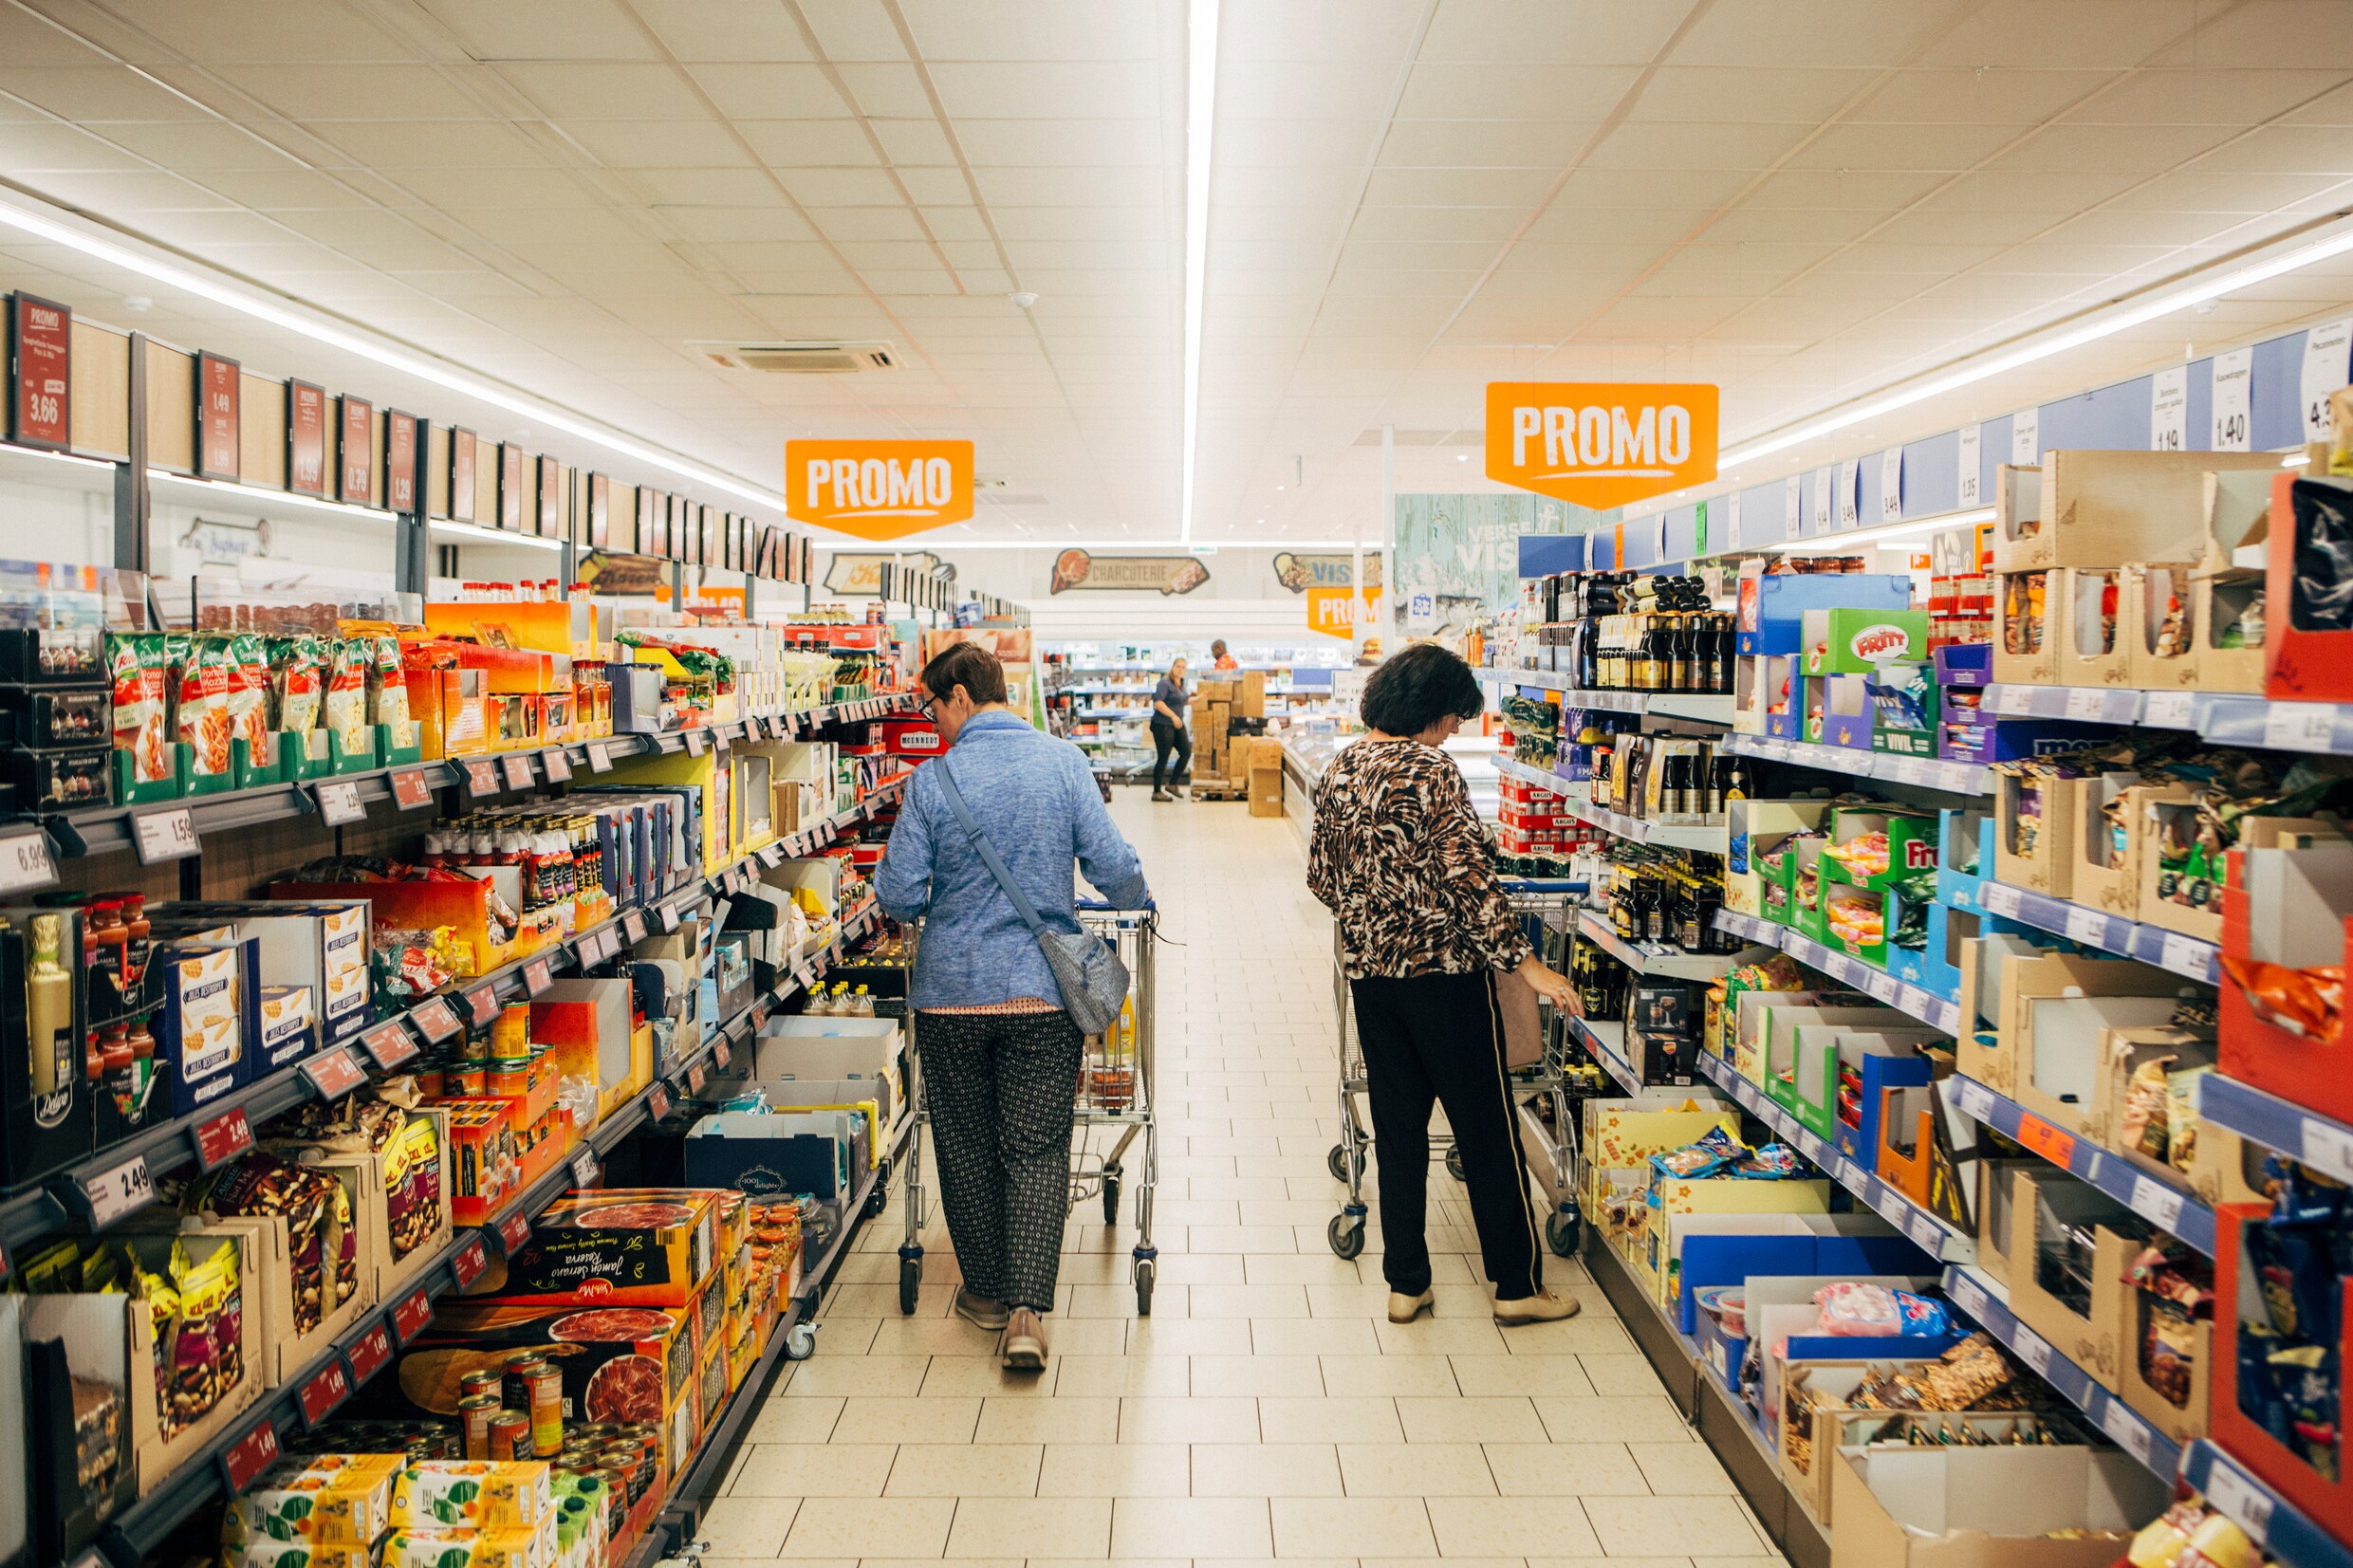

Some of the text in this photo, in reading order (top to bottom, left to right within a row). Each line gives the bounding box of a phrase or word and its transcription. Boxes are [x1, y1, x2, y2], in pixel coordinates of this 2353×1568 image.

[30, 307, 59, 328] PROMO
[30, 393, 58, 425] 3.66
[213, 391, 231, 414] 1.49
[1513, 405, 1691, 467] PROMO
[2158, 430, 2178, 451] 119
[2217, 414, 2244, 447] 1.40
[807, 457, 952, 508] PROMO
[1962, 477, 1976, 498] 1.35
[1884, 495, 1898, 514] 3.49
[1468, 521, 1530, 544] VERSE
[1455, 542, 1517, 572] VIS
[1093, 565, 1167, 581] CHARCUTERIE
[1312, 562, 1351, 583] VIS
[171, 817, 194, 841] 1.59
[18, 843, 47, 872] 6.99
[188, 981, 224, 1002] JULES DESTROOPER
[190, 1051, 226, 1072] JULES DESTROOPER
[39, 1091, 68, 1118] Deluxe
[230, 1119, 249, 1142] 2.49
[121, 1165, 149, 1198] 2.49
[218, 1167, 239, 1196] Alesto
[240, 1169, 256, 1185] Mix
[551, 1255, 623, 1280] Jamón Serrano
[565, 1252, 602, 1264] Reserva
[417, 1298, 429, 1318] 1.49
[374, 1333, 387, 1356] 1.49
[329, 1370, 344, 1394] 1.49
[259, 1430, 276, 1457] 1.49
